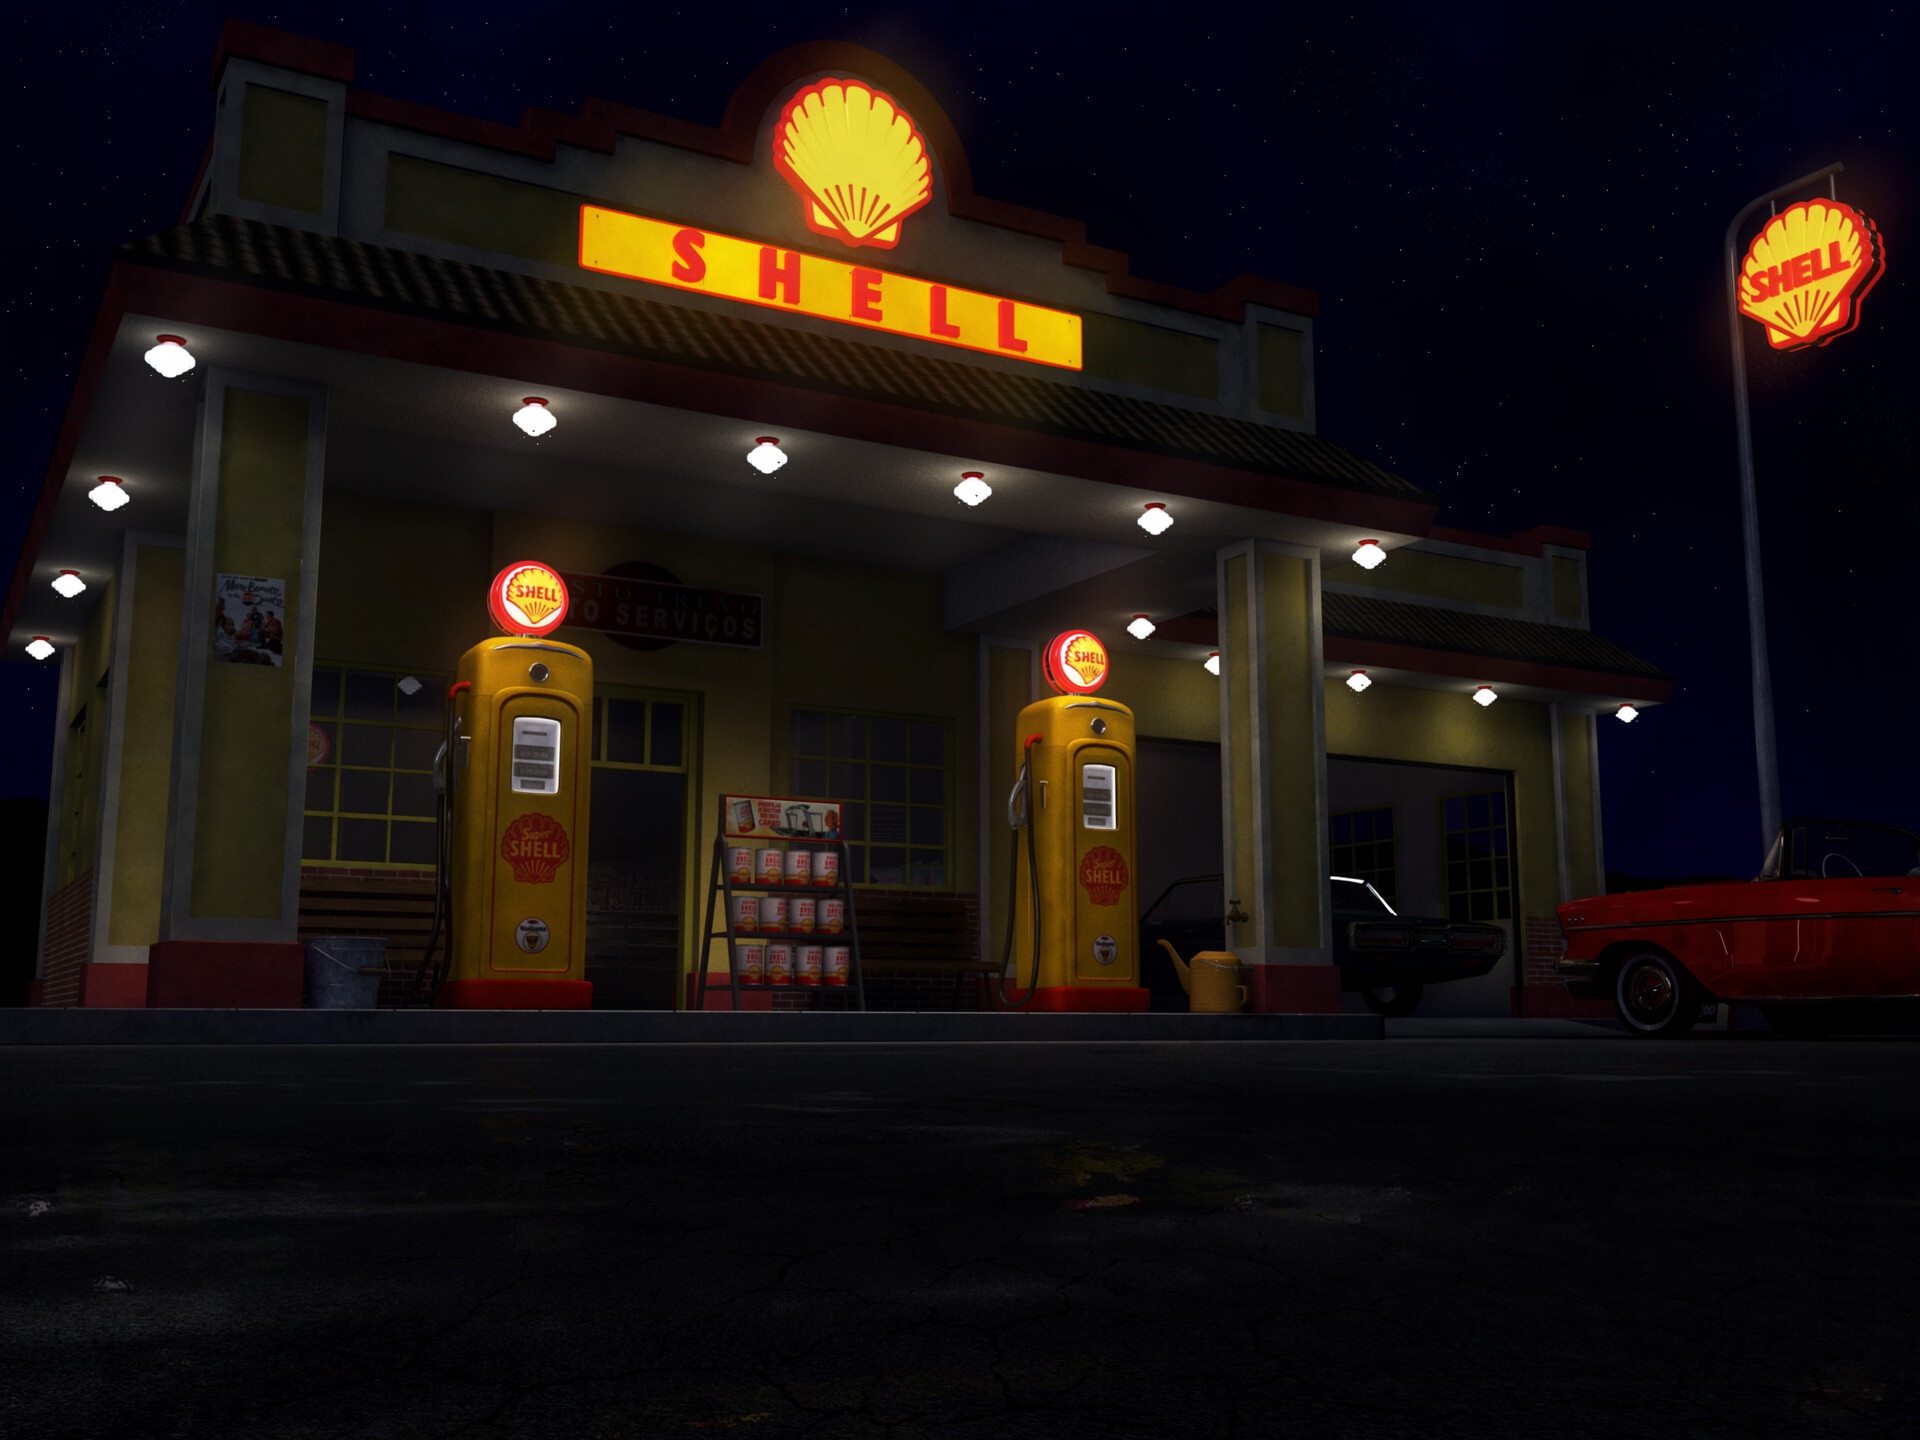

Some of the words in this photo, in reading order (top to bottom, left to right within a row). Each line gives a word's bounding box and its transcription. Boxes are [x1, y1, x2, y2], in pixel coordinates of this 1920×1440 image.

[1750, 241, 1851, 303] SHELL
[671, 228, 1028, 353] SHELL
[516, 585, 558, 602] SHELL
[572, 579, 632, 601] STO
[651, 588, 758, 616] TREVO
[569, 597, 600, 622] TO
[616, 604, 755, 640] SERVIÇOS
[1074, 651, 1104, 665] SHELL
[522, 827, 552, 841] Super
[510, 839, 561, 858] SHELL
[1086, 869, 1122, 884] SHELL
